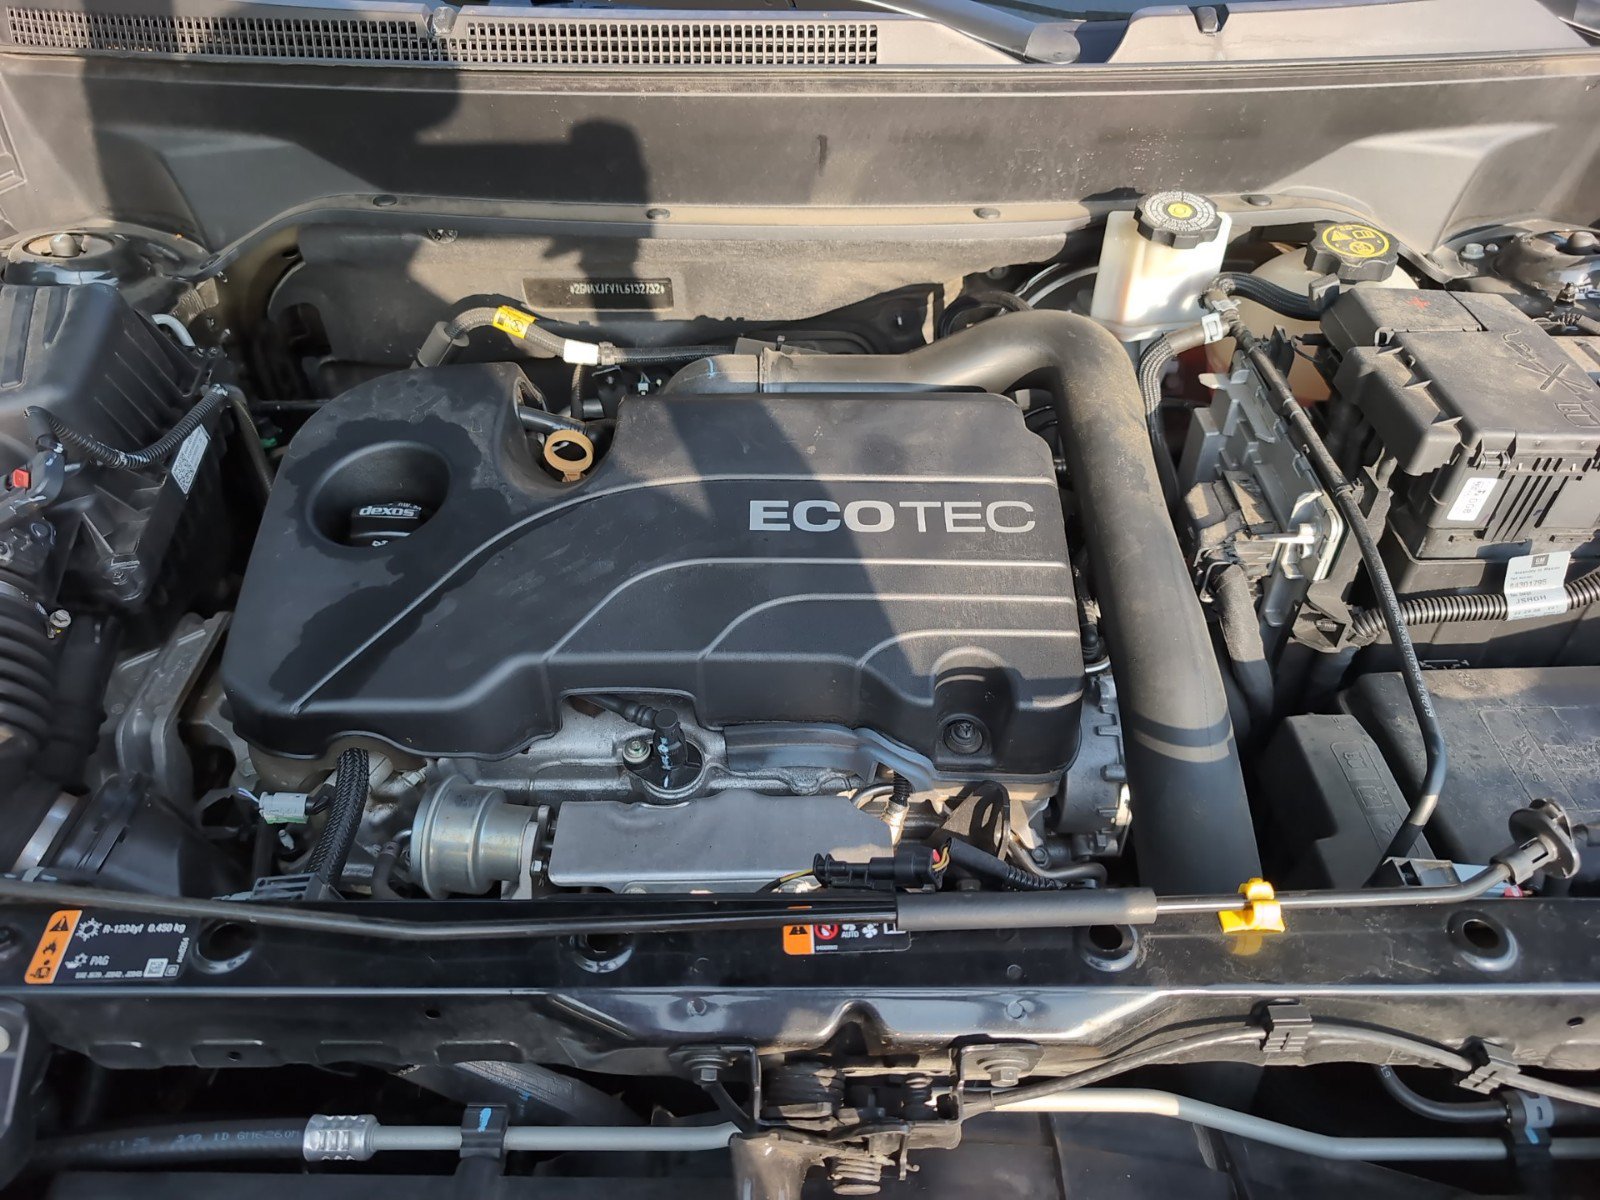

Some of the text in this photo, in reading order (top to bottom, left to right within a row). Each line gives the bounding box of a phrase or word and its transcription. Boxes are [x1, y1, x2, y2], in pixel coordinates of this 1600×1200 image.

[359, 506, 416, 517] dexos
[749, 500, 1036, 533] ECOTEC
[173, 922, 186, 934] kg
[841, 930, 860, 938] AUTO
[89, 955, 110, 966] PAG
